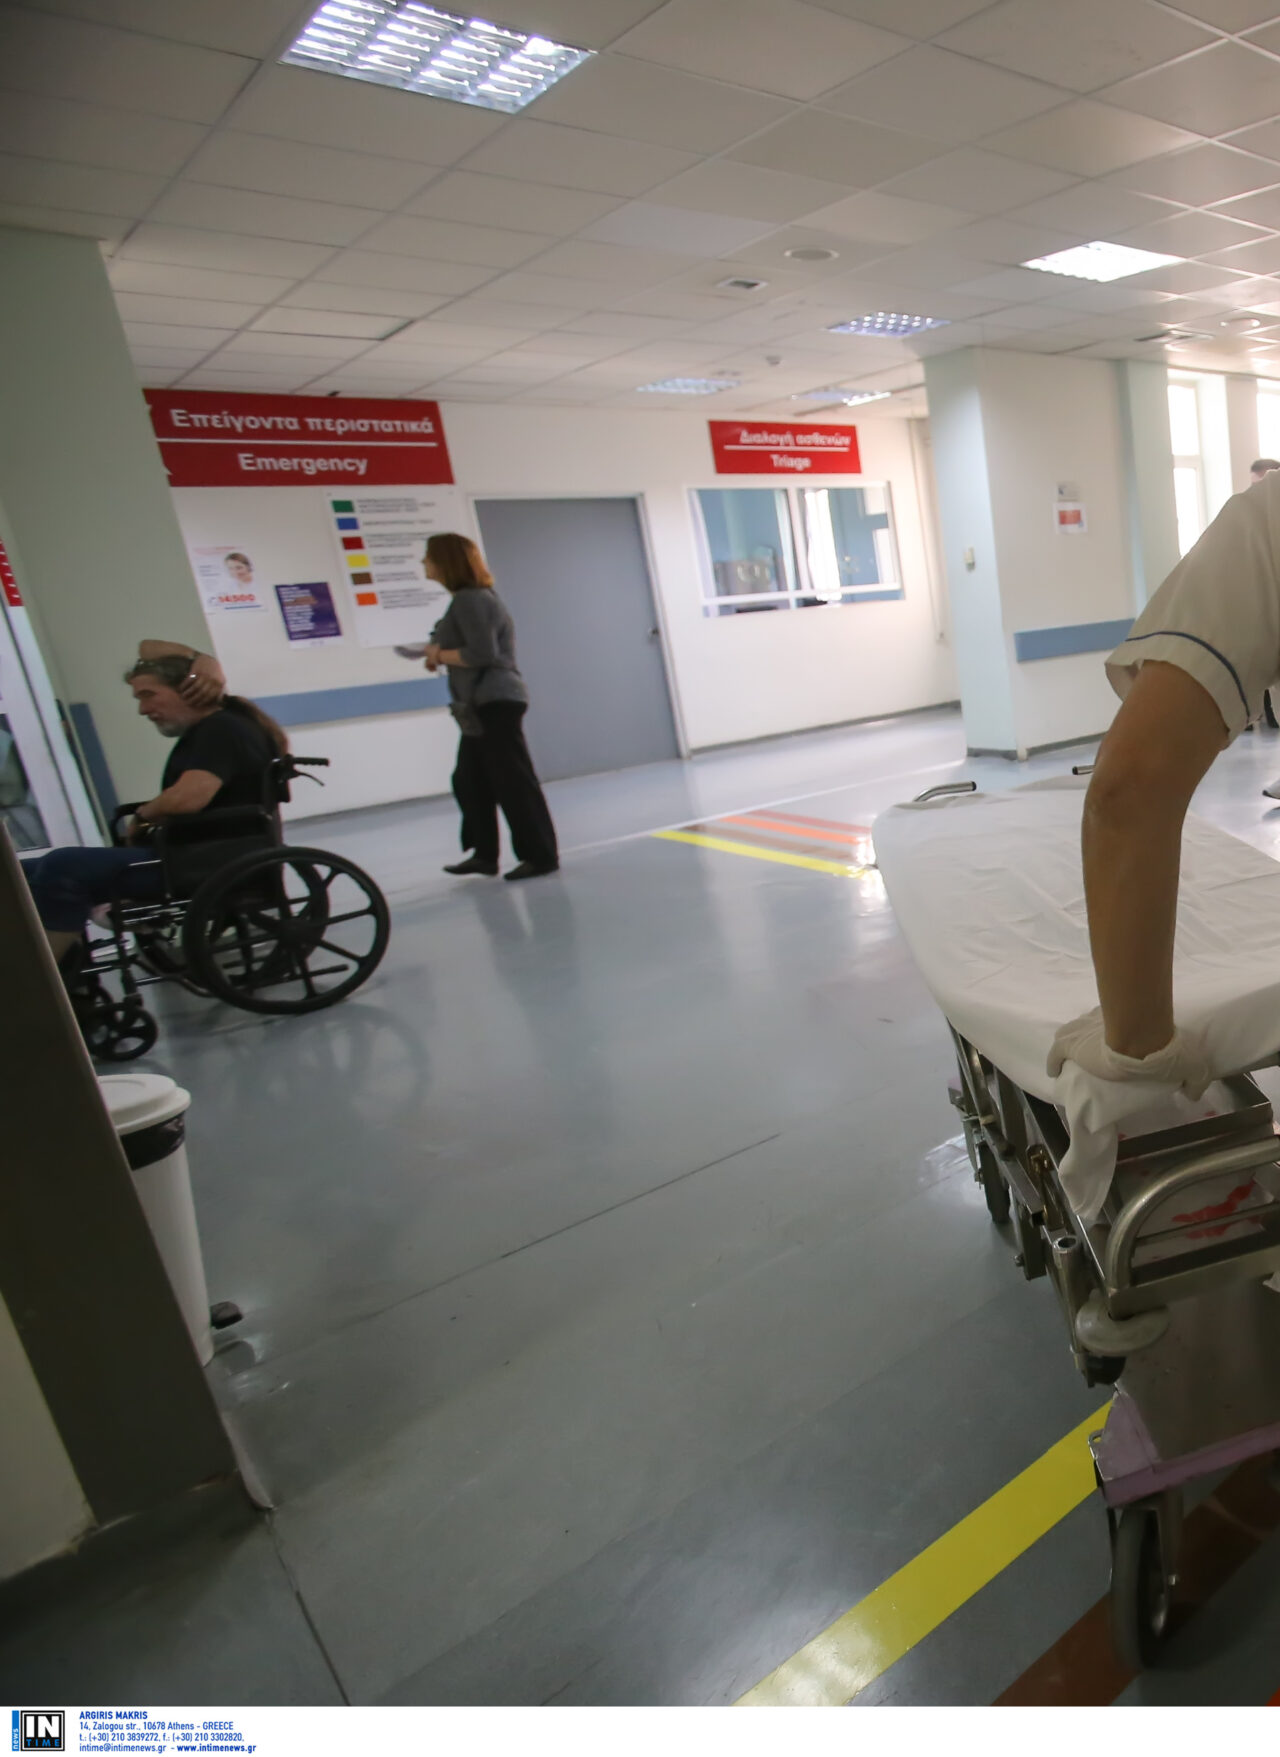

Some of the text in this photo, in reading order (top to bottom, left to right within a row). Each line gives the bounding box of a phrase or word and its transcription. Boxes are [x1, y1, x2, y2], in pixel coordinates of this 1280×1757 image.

[169, 408, 434, 435] Επείγοντα περιστατικά
[237, 453, 368, 475] Emergency
[770, 454, 811, 471] Triage
